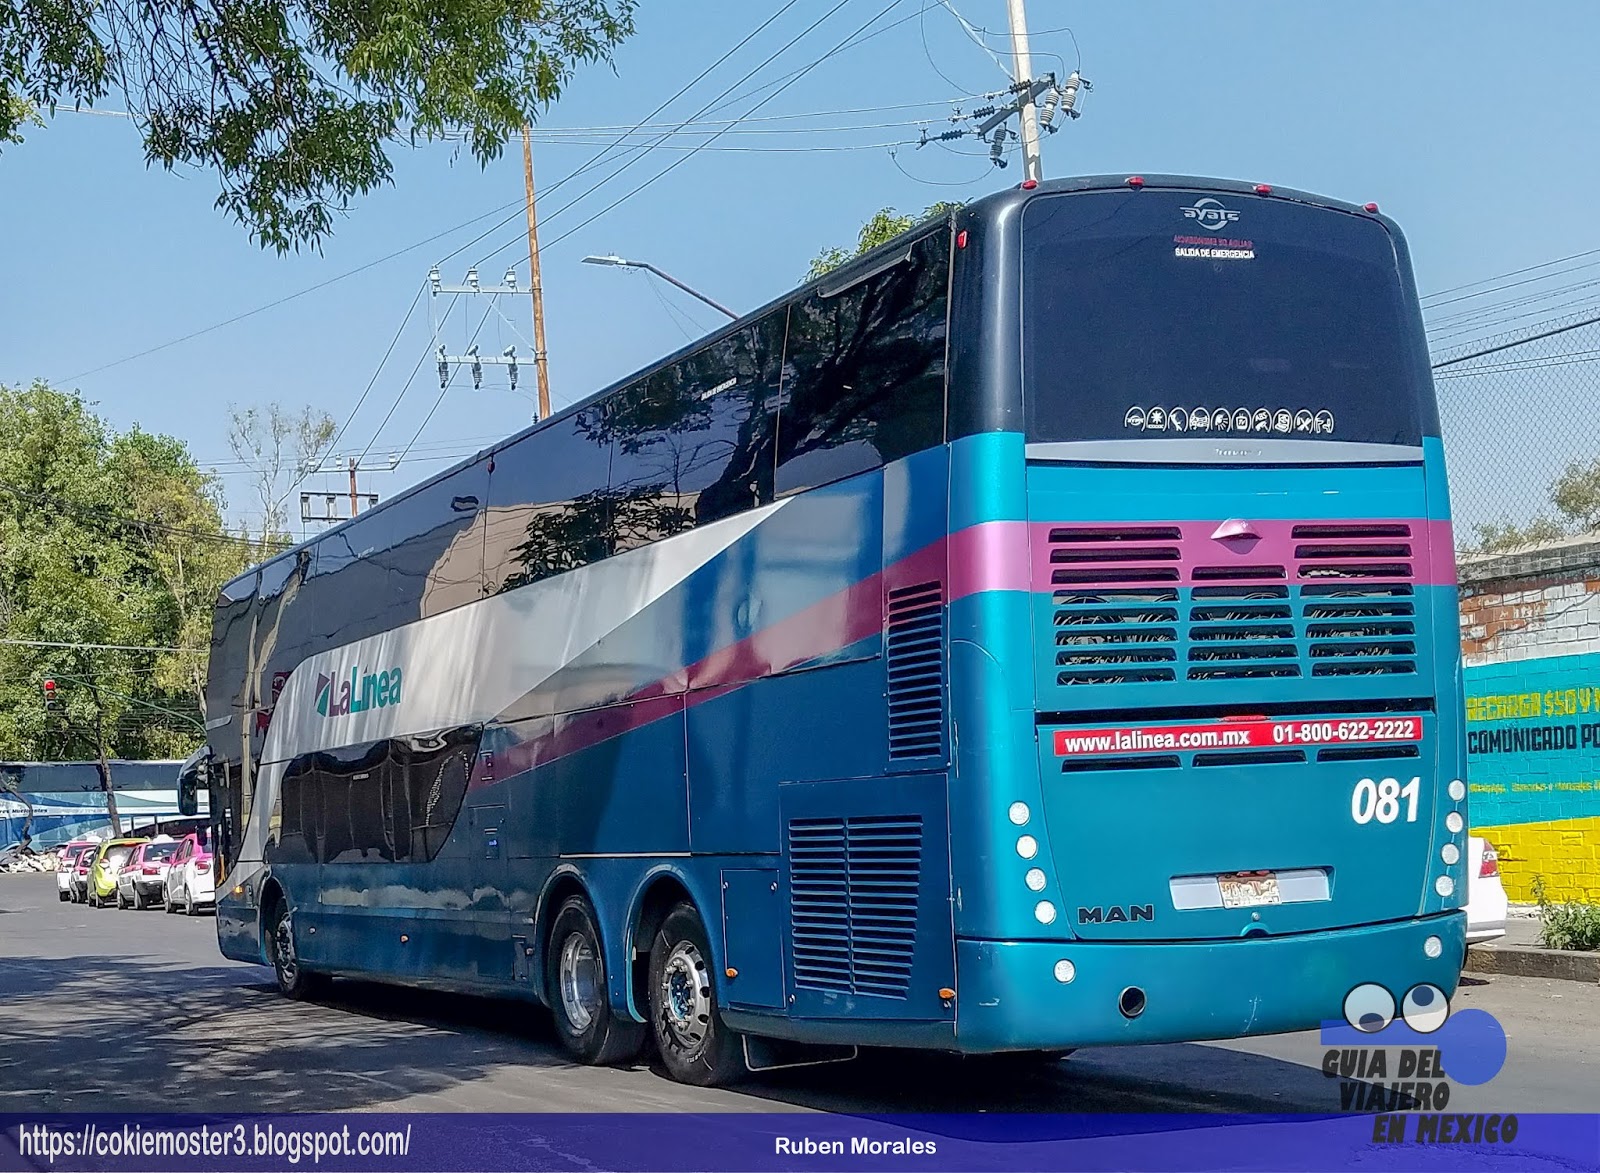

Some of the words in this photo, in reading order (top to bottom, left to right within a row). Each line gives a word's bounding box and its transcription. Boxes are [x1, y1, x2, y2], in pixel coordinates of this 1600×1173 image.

[1175, 247, 1200, 257] SALIDA
[1200, 248, 1211, 257] DE
[1211, 249, 1255, 259] EMERGENCIA
[1065, 727, 1250, 753] www.lalinea.com.mx
[1272, 720, 1414, 744] 01-800-622-2222
[1468, 724, 1577, 754] COMUNICADO
[1351, 775, 1421, 825] 081
[1078, 904, 1153, 924] MAN
